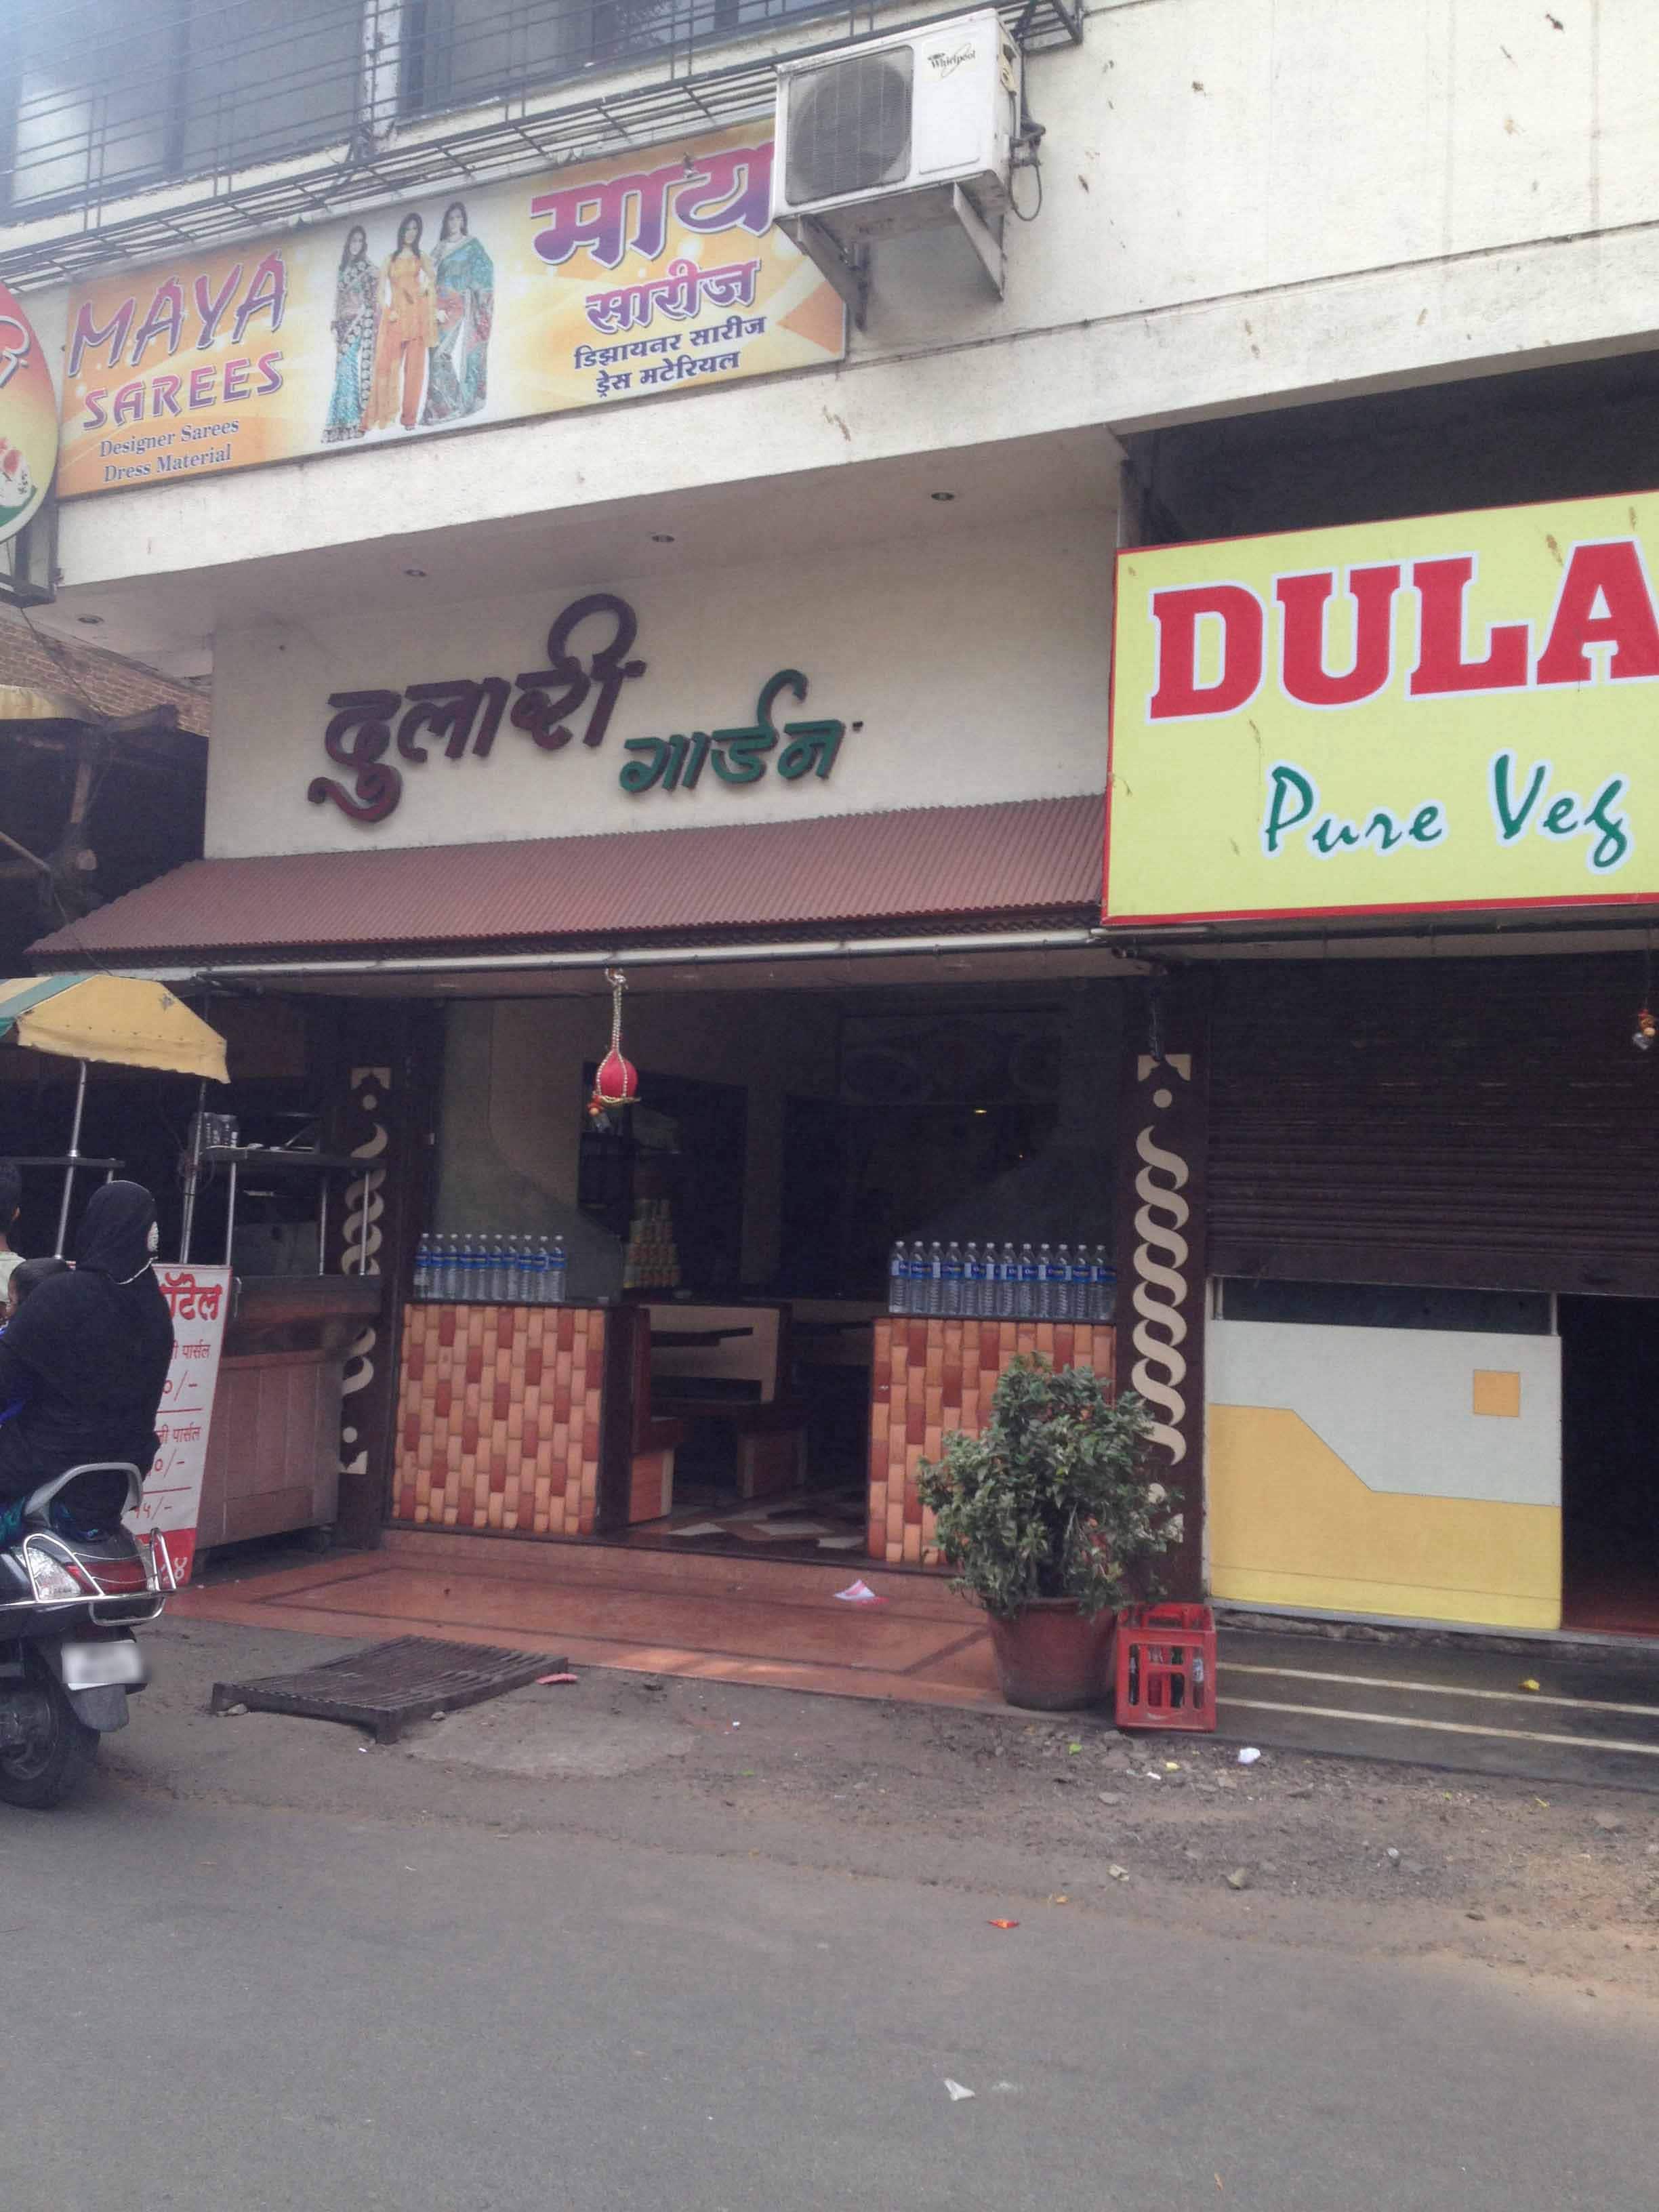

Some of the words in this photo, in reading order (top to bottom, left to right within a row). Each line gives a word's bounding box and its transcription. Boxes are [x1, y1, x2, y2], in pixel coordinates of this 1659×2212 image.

[531, 141, 775, 269] माय
[68, 249, 286, 377] MAYA
[585, 258, 761, 333] सारीज
[574, 333, 682, 369] डिझायनर
[689, 315, 766, 346] सारीज
[596, 369, 632, 398] ड्रेस
[639, 350, 741, 384] मटेरियल
[82, 350, 283, 430] SAREES
[100, 434, 176, 457] Designer
[181, 419, 239, 442] Sarees
[104, 462, 150, 482] Dress
[157, 443, 231, 473] Material
[1149, 540, 1659, 720] DULA
[307, 593, 648, 823] दुलारी
[619, 668, 847, 794] गार्डन
[1267, 764, 1444, 853] Pure
[1493, 754, 1629, 869] Veg
[158, 1272, 222, 1321] ॉटेल
